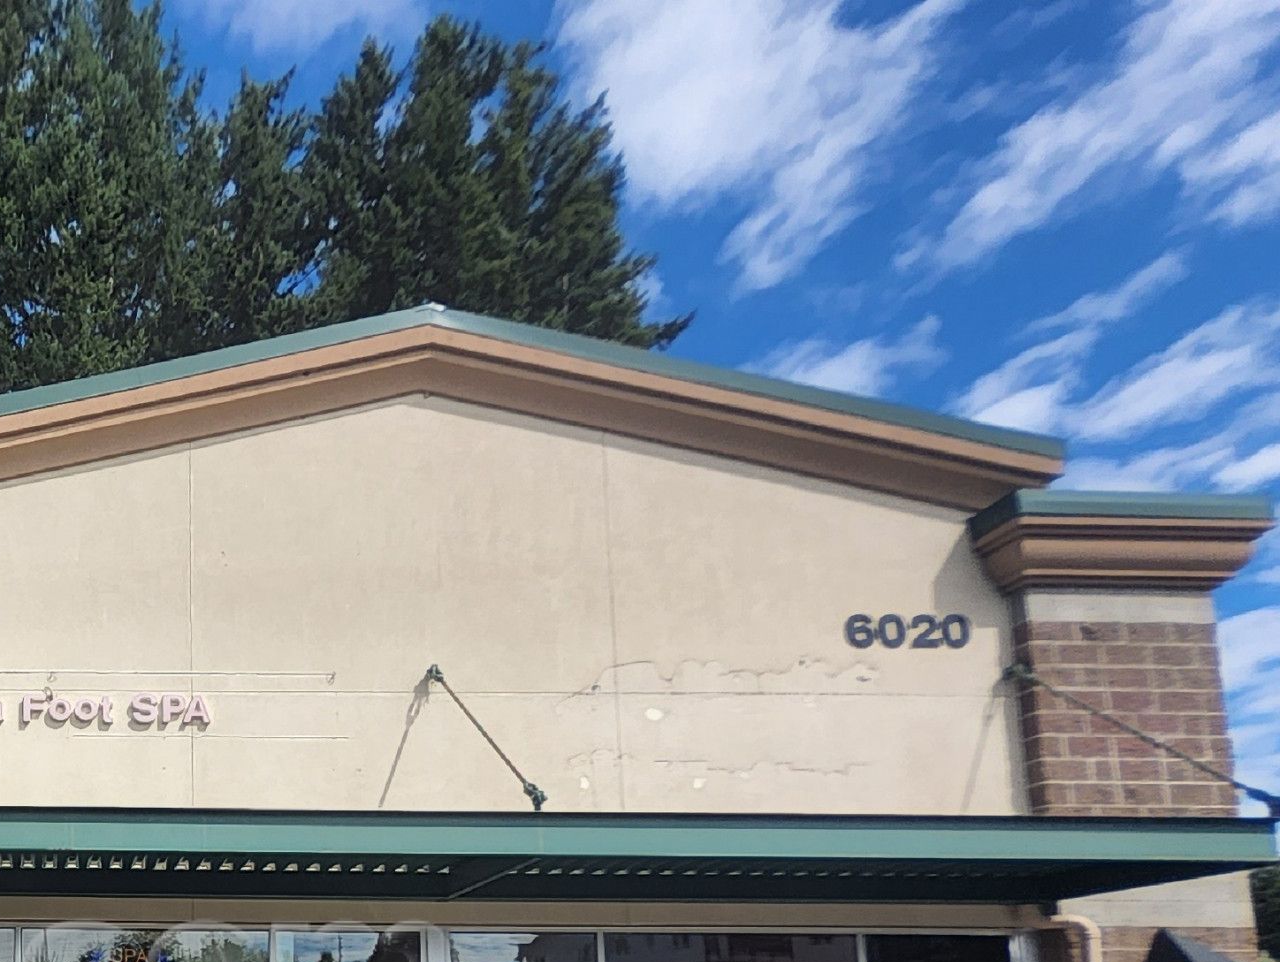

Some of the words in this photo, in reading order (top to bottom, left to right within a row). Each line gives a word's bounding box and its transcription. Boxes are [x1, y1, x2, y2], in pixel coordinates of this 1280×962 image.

[845, 614, 970, 649] 6020
[21, 693, 113, 727] Foot
[129, 692, 210, 727] SPA
